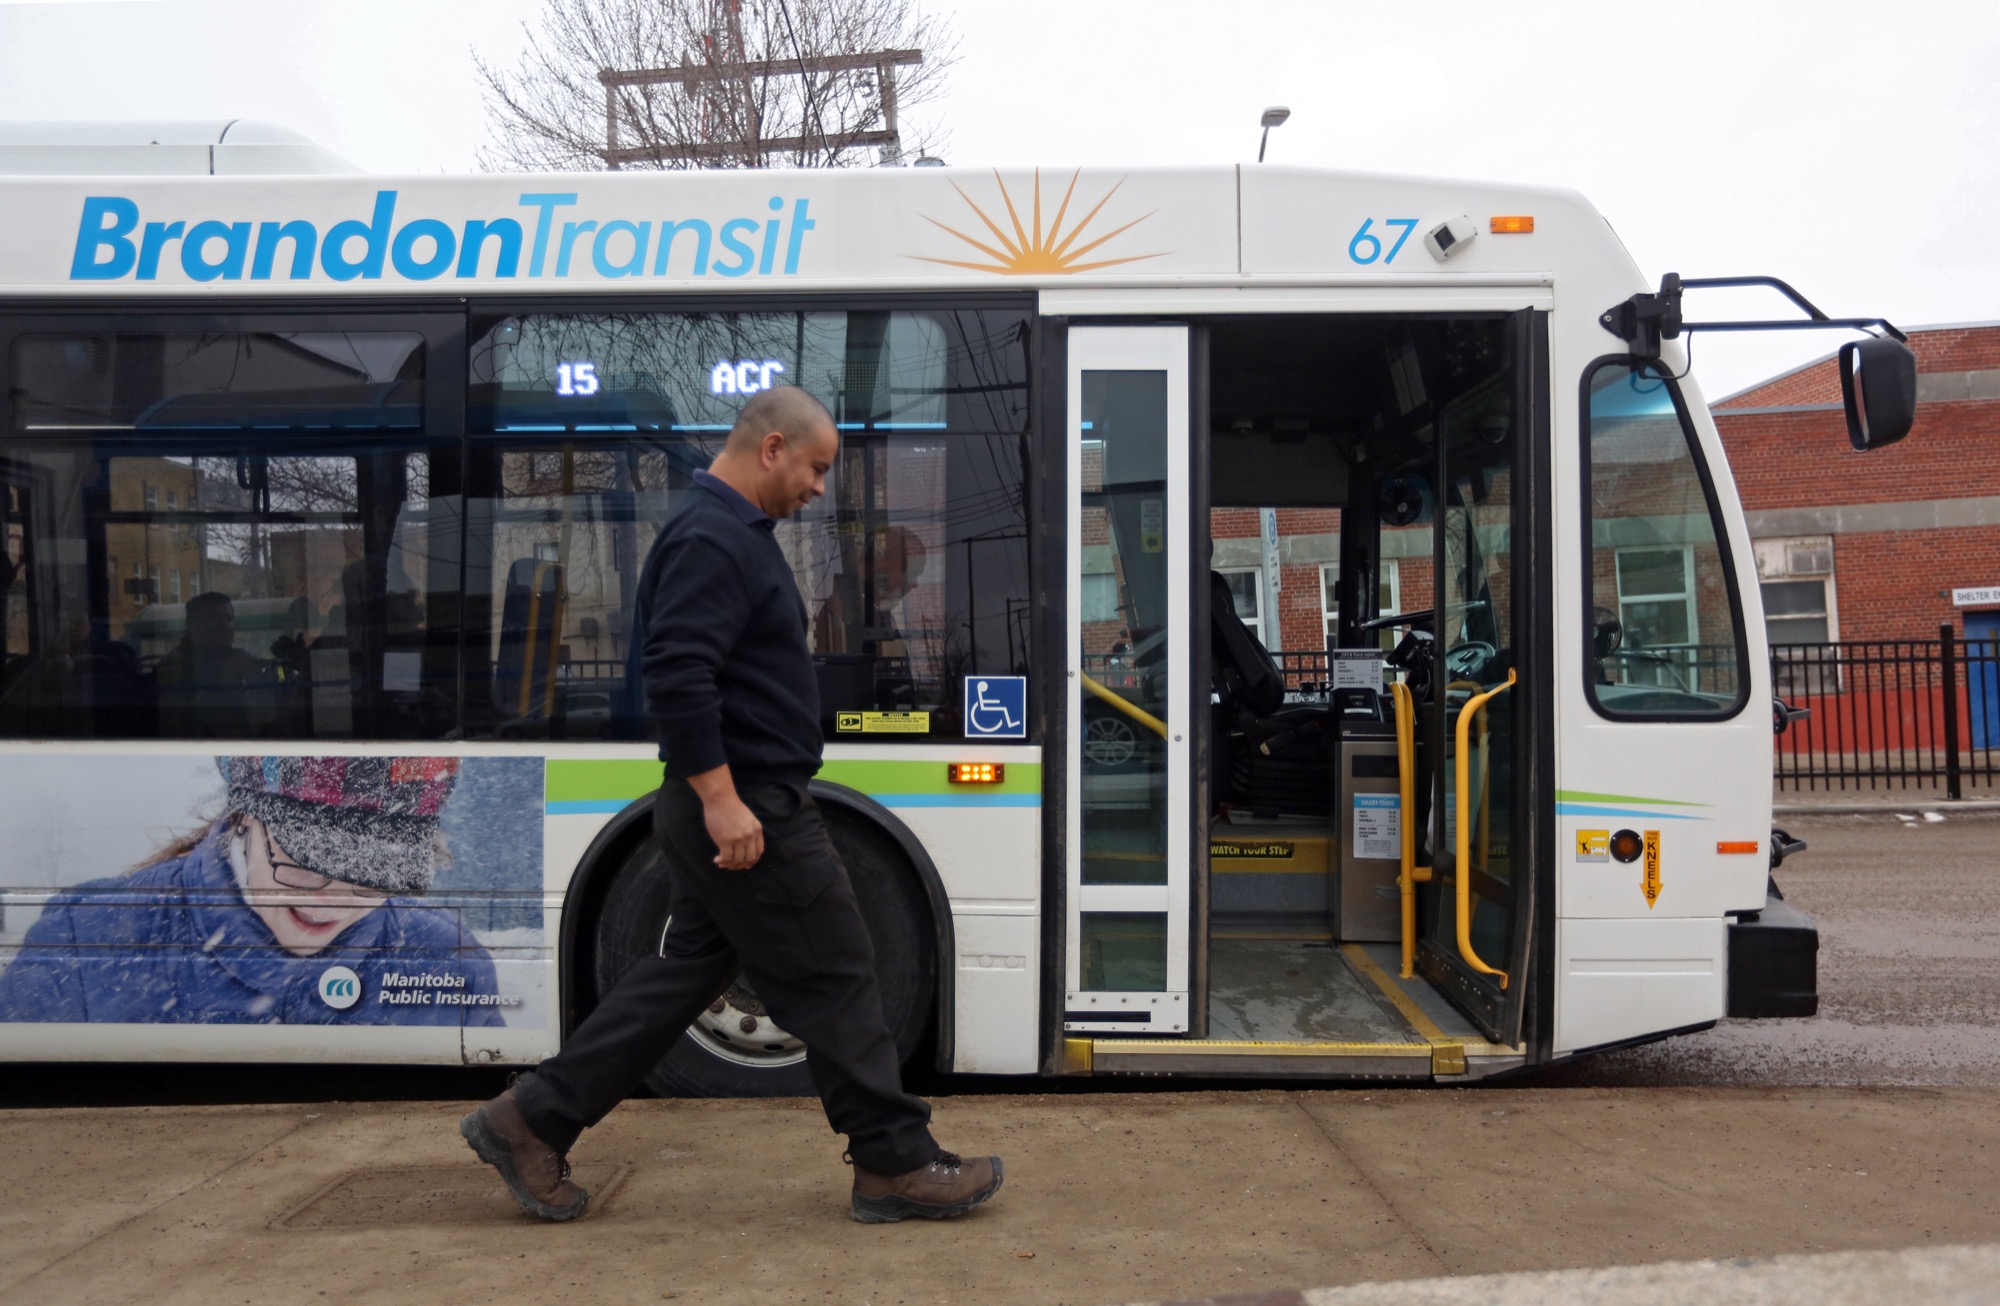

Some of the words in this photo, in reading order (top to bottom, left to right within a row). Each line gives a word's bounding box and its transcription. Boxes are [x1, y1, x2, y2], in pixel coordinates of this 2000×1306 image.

[1348, 217, 1420, 265] 67
[556, 362, 599, 396] 15
[1957, 592, 1989, 601] SHELTER
[1211, 845, 1240, 855] WATCH
[1646, 841, 1657, 899] KNEELS
[381, 972, 466, 988] Manitoba
[378, 990, 432, 1005] Public
[435, 990, 520, 1006] Insurance
